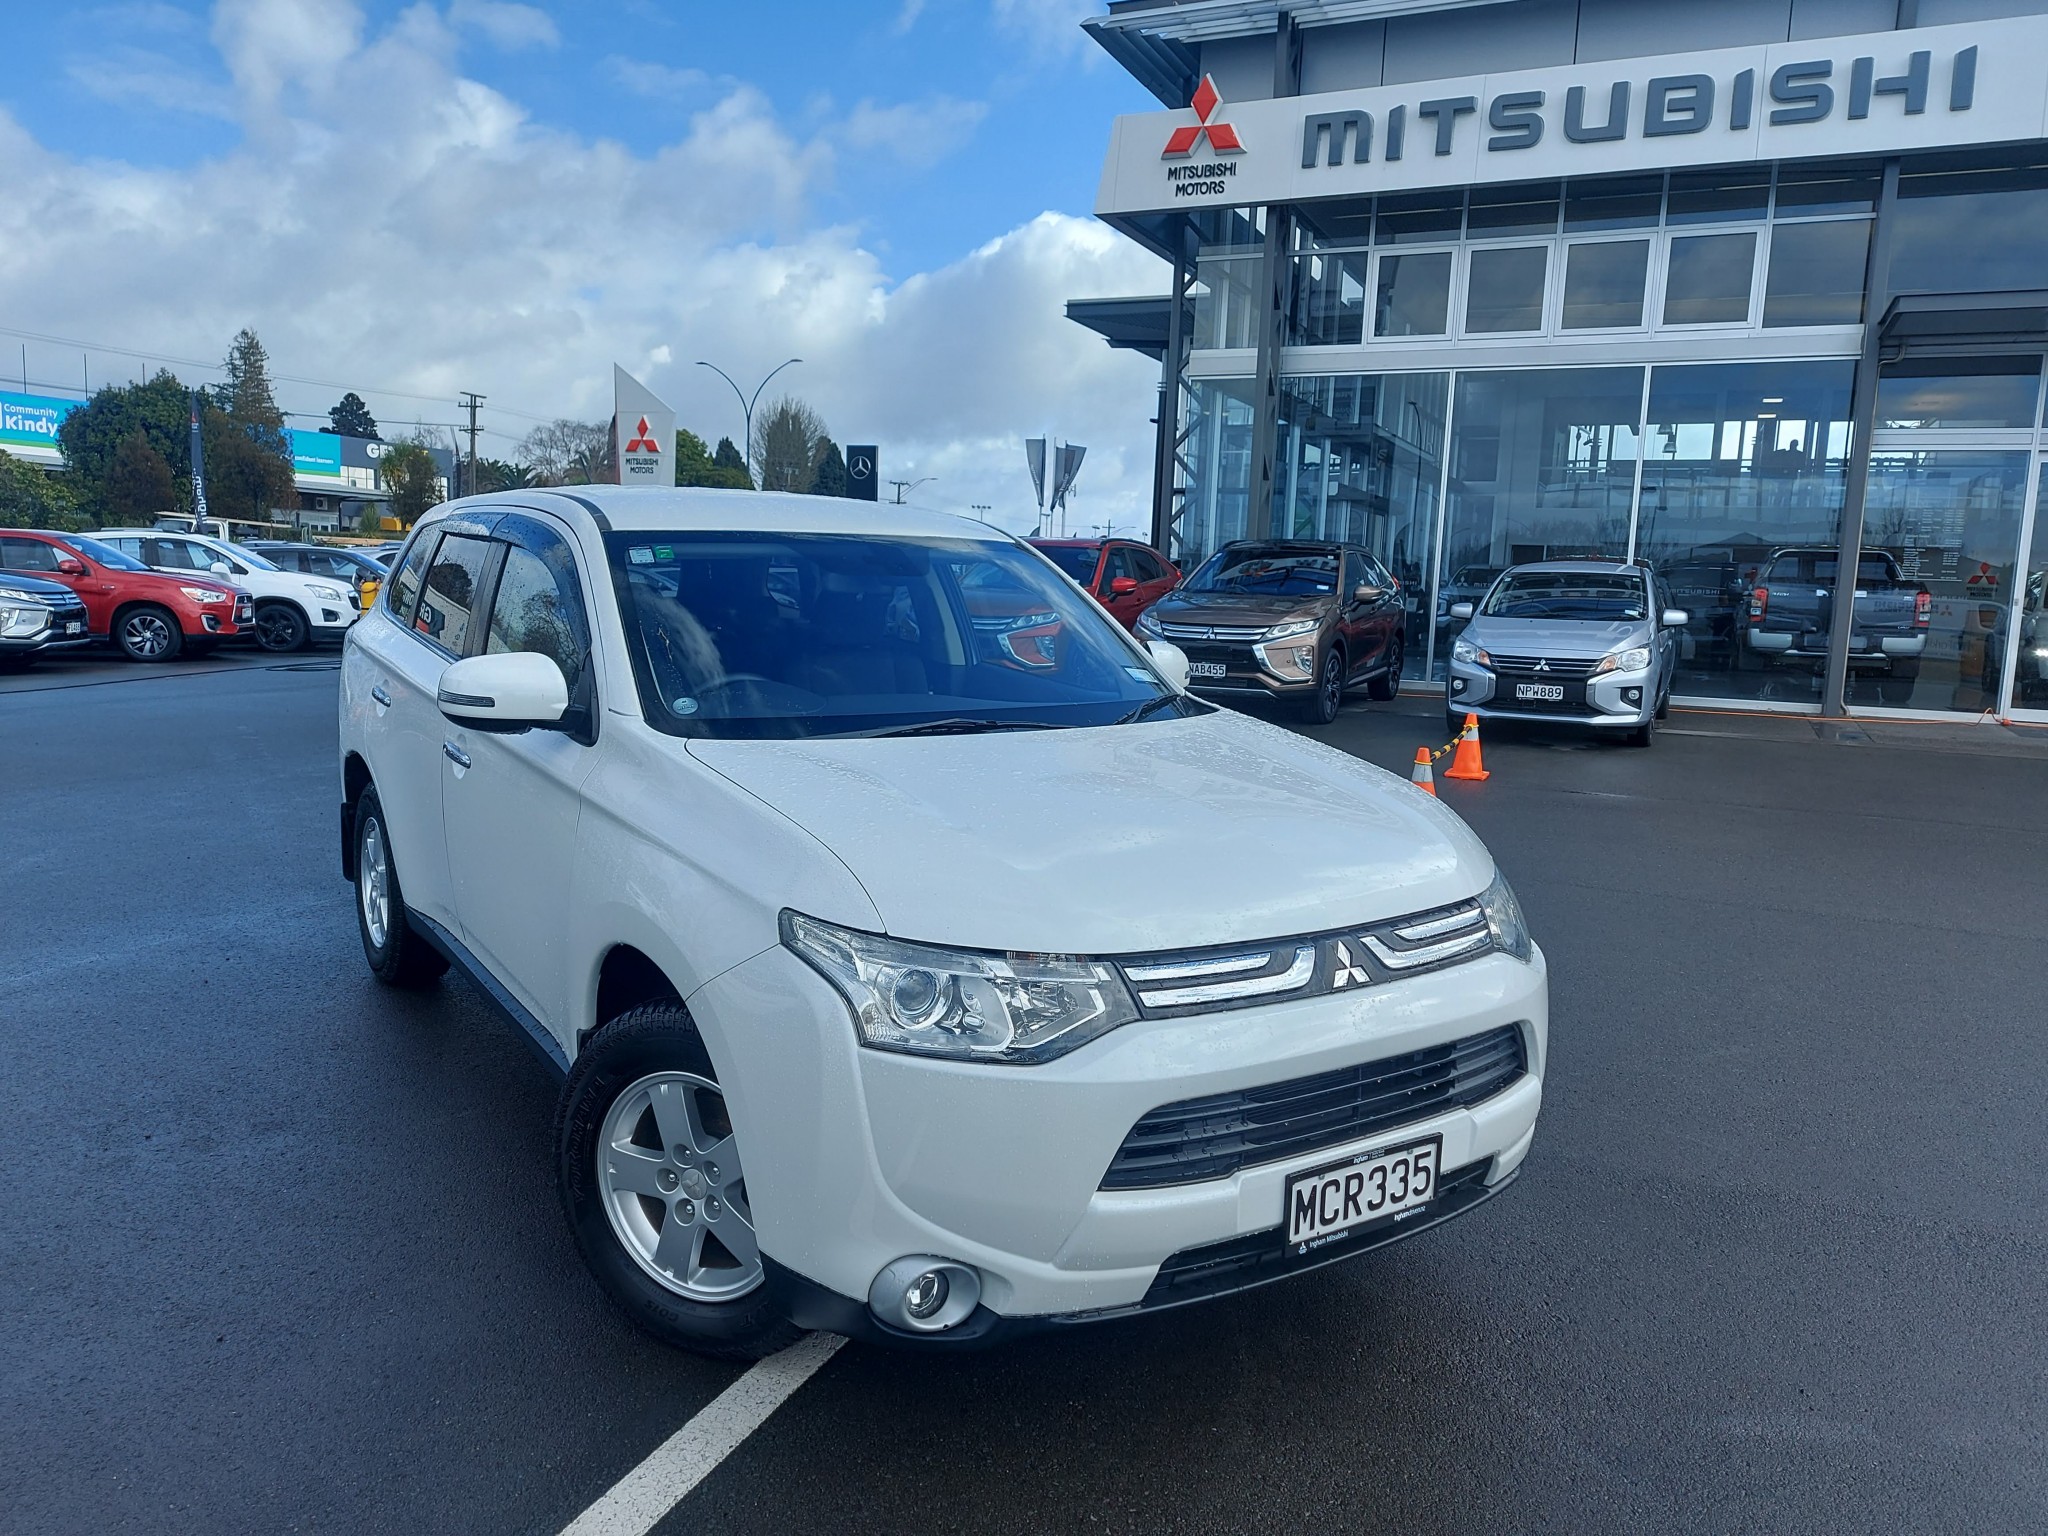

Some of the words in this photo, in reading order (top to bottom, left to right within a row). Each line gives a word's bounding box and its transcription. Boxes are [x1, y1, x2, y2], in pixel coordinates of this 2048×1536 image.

[1301, 44, 1978, 169] MITSUBISHI
[1168, 162, 1236, 181] MITSUBISHI
[1175, 180, 1225, 197] MOTORS
[4, 403, 57, 419] Community
[5, 414, 58, 437] Kindy
[625, 457, 659, 466] MITSUBISHI
[630, 466, 654, 474] MOTORS
[1190, 664, 1225, 675] NAB455
[1517, 685, 1562, 698] NPW889
[1294, 1150, 1432, 1236] MCR335
